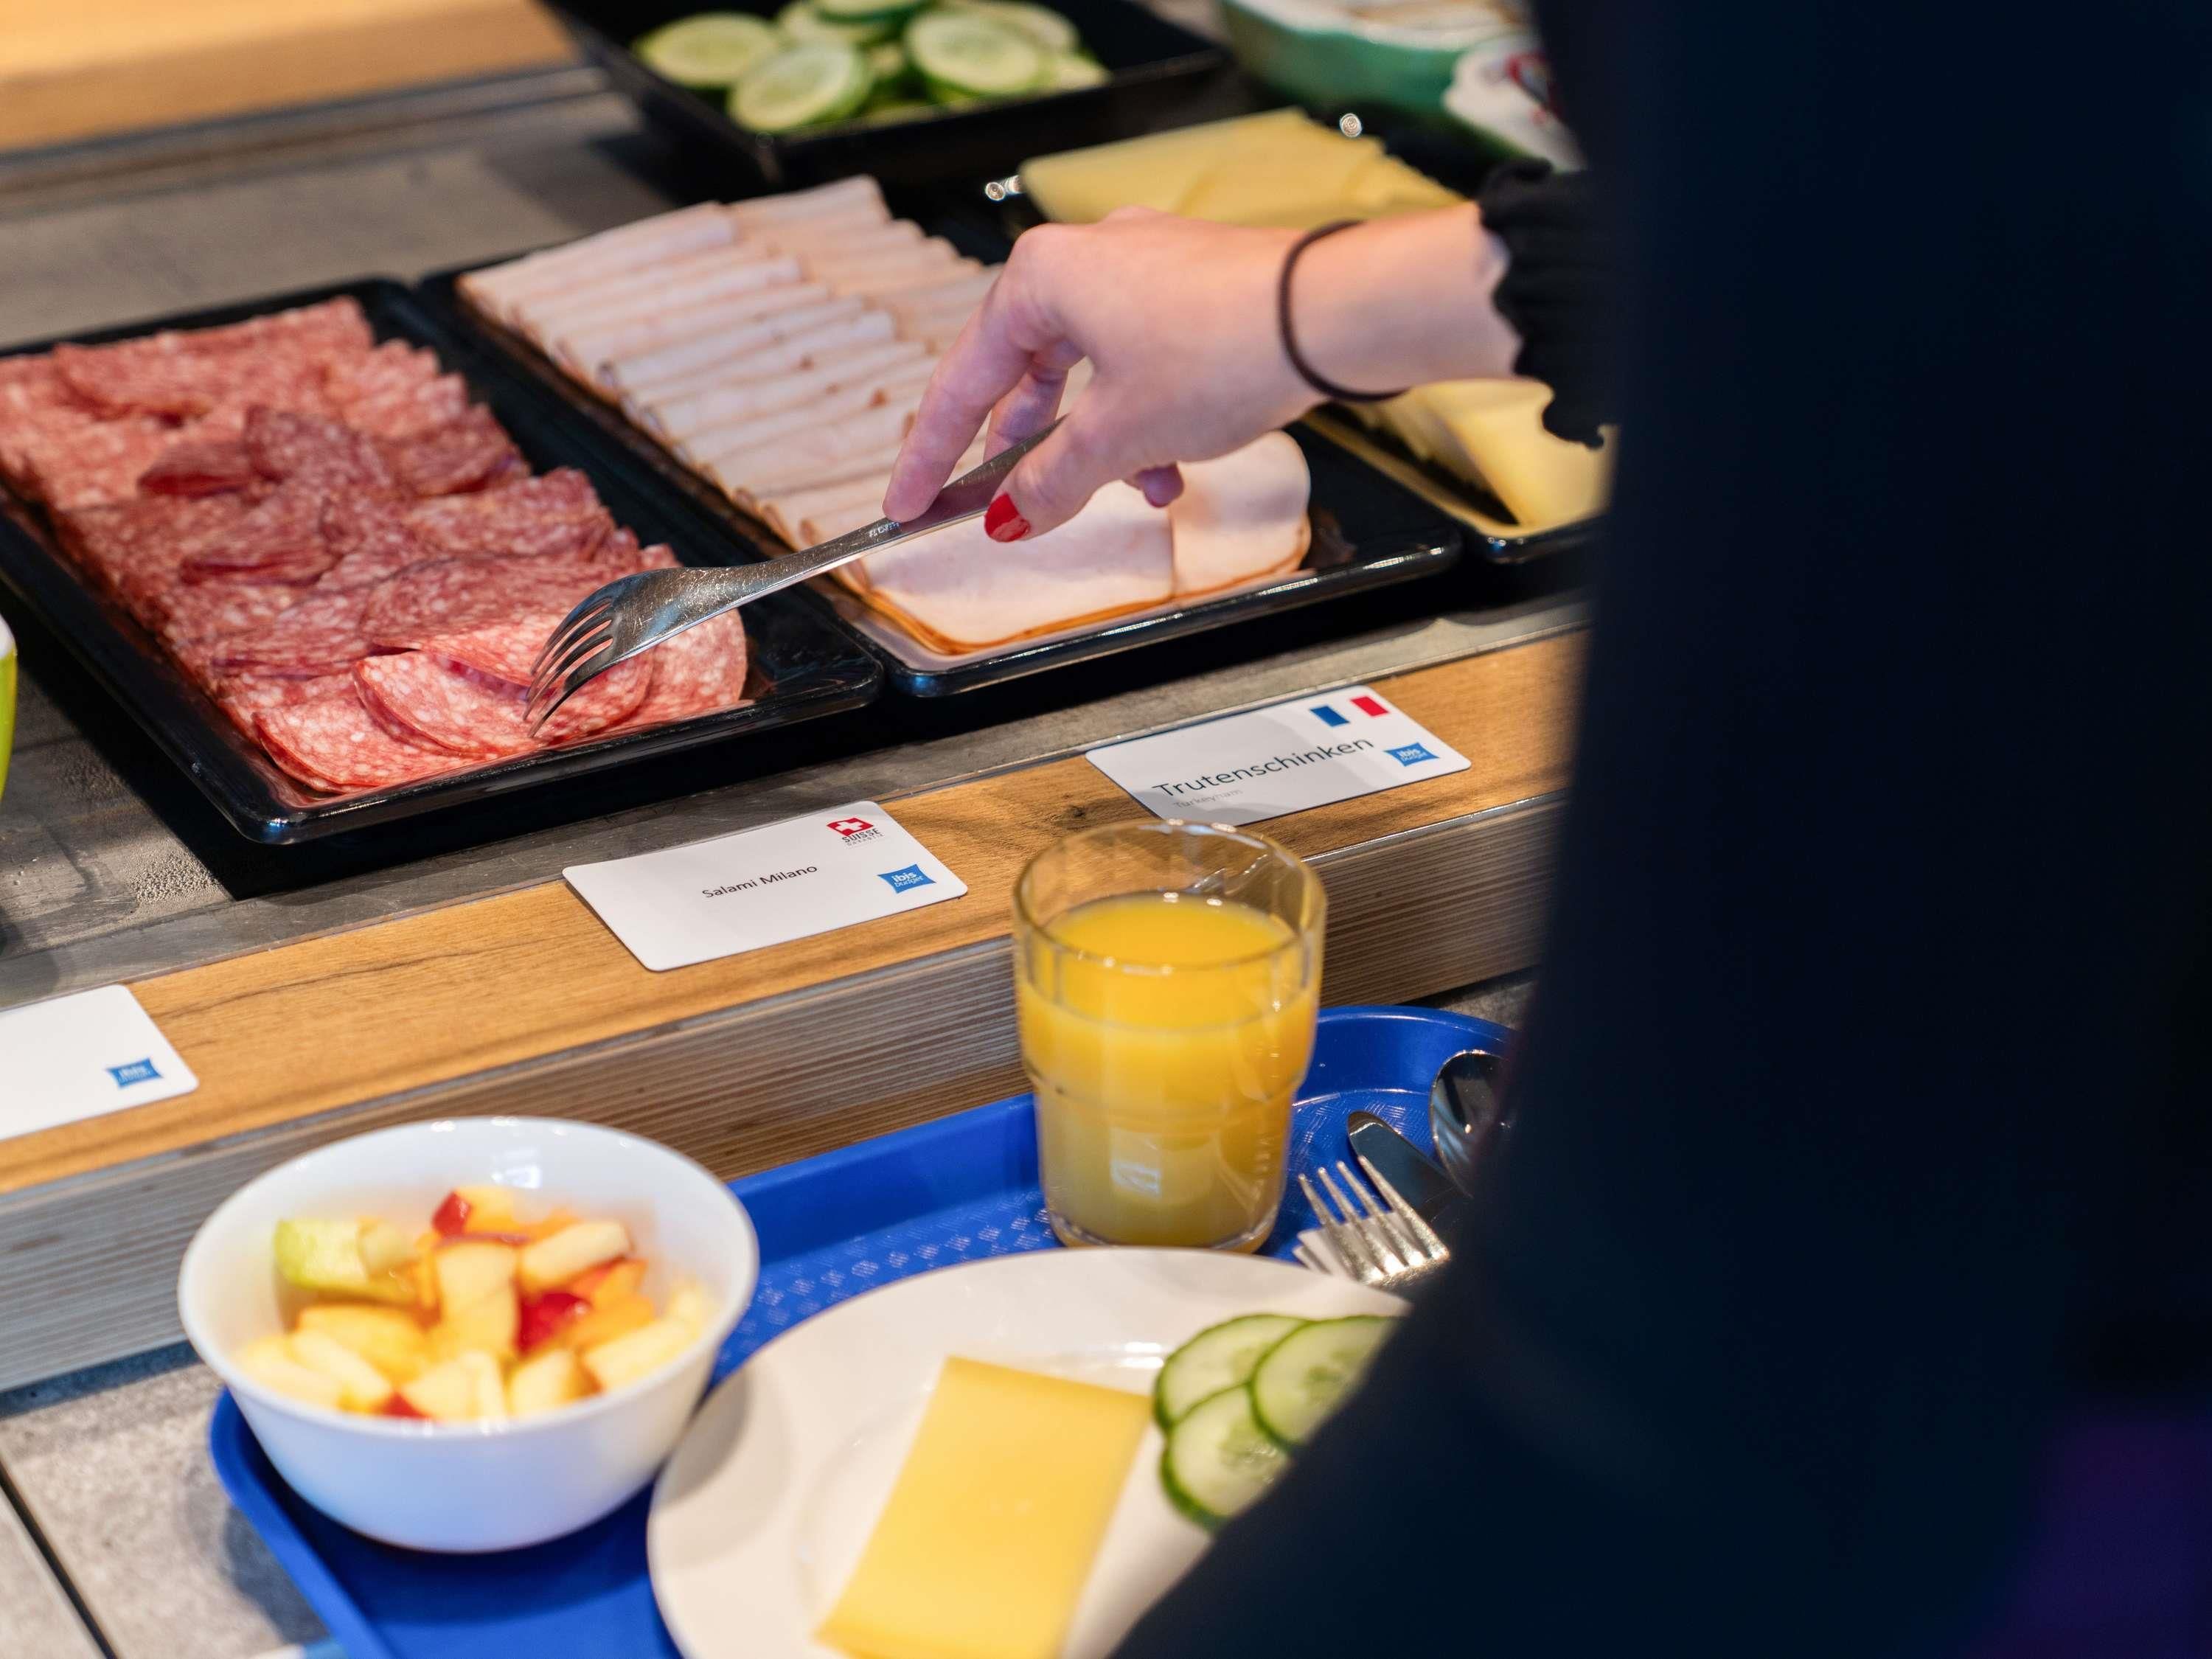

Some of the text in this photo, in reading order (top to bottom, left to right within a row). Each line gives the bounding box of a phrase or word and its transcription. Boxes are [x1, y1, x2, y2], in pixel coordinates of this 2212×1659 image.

[1152, 737, 1374, 796] Trutenschinken
[842, 828, 880, 843] SUISSE
[702, 866, 817, 897] Salami Milano
[891, 872, 917, 883] ibis
